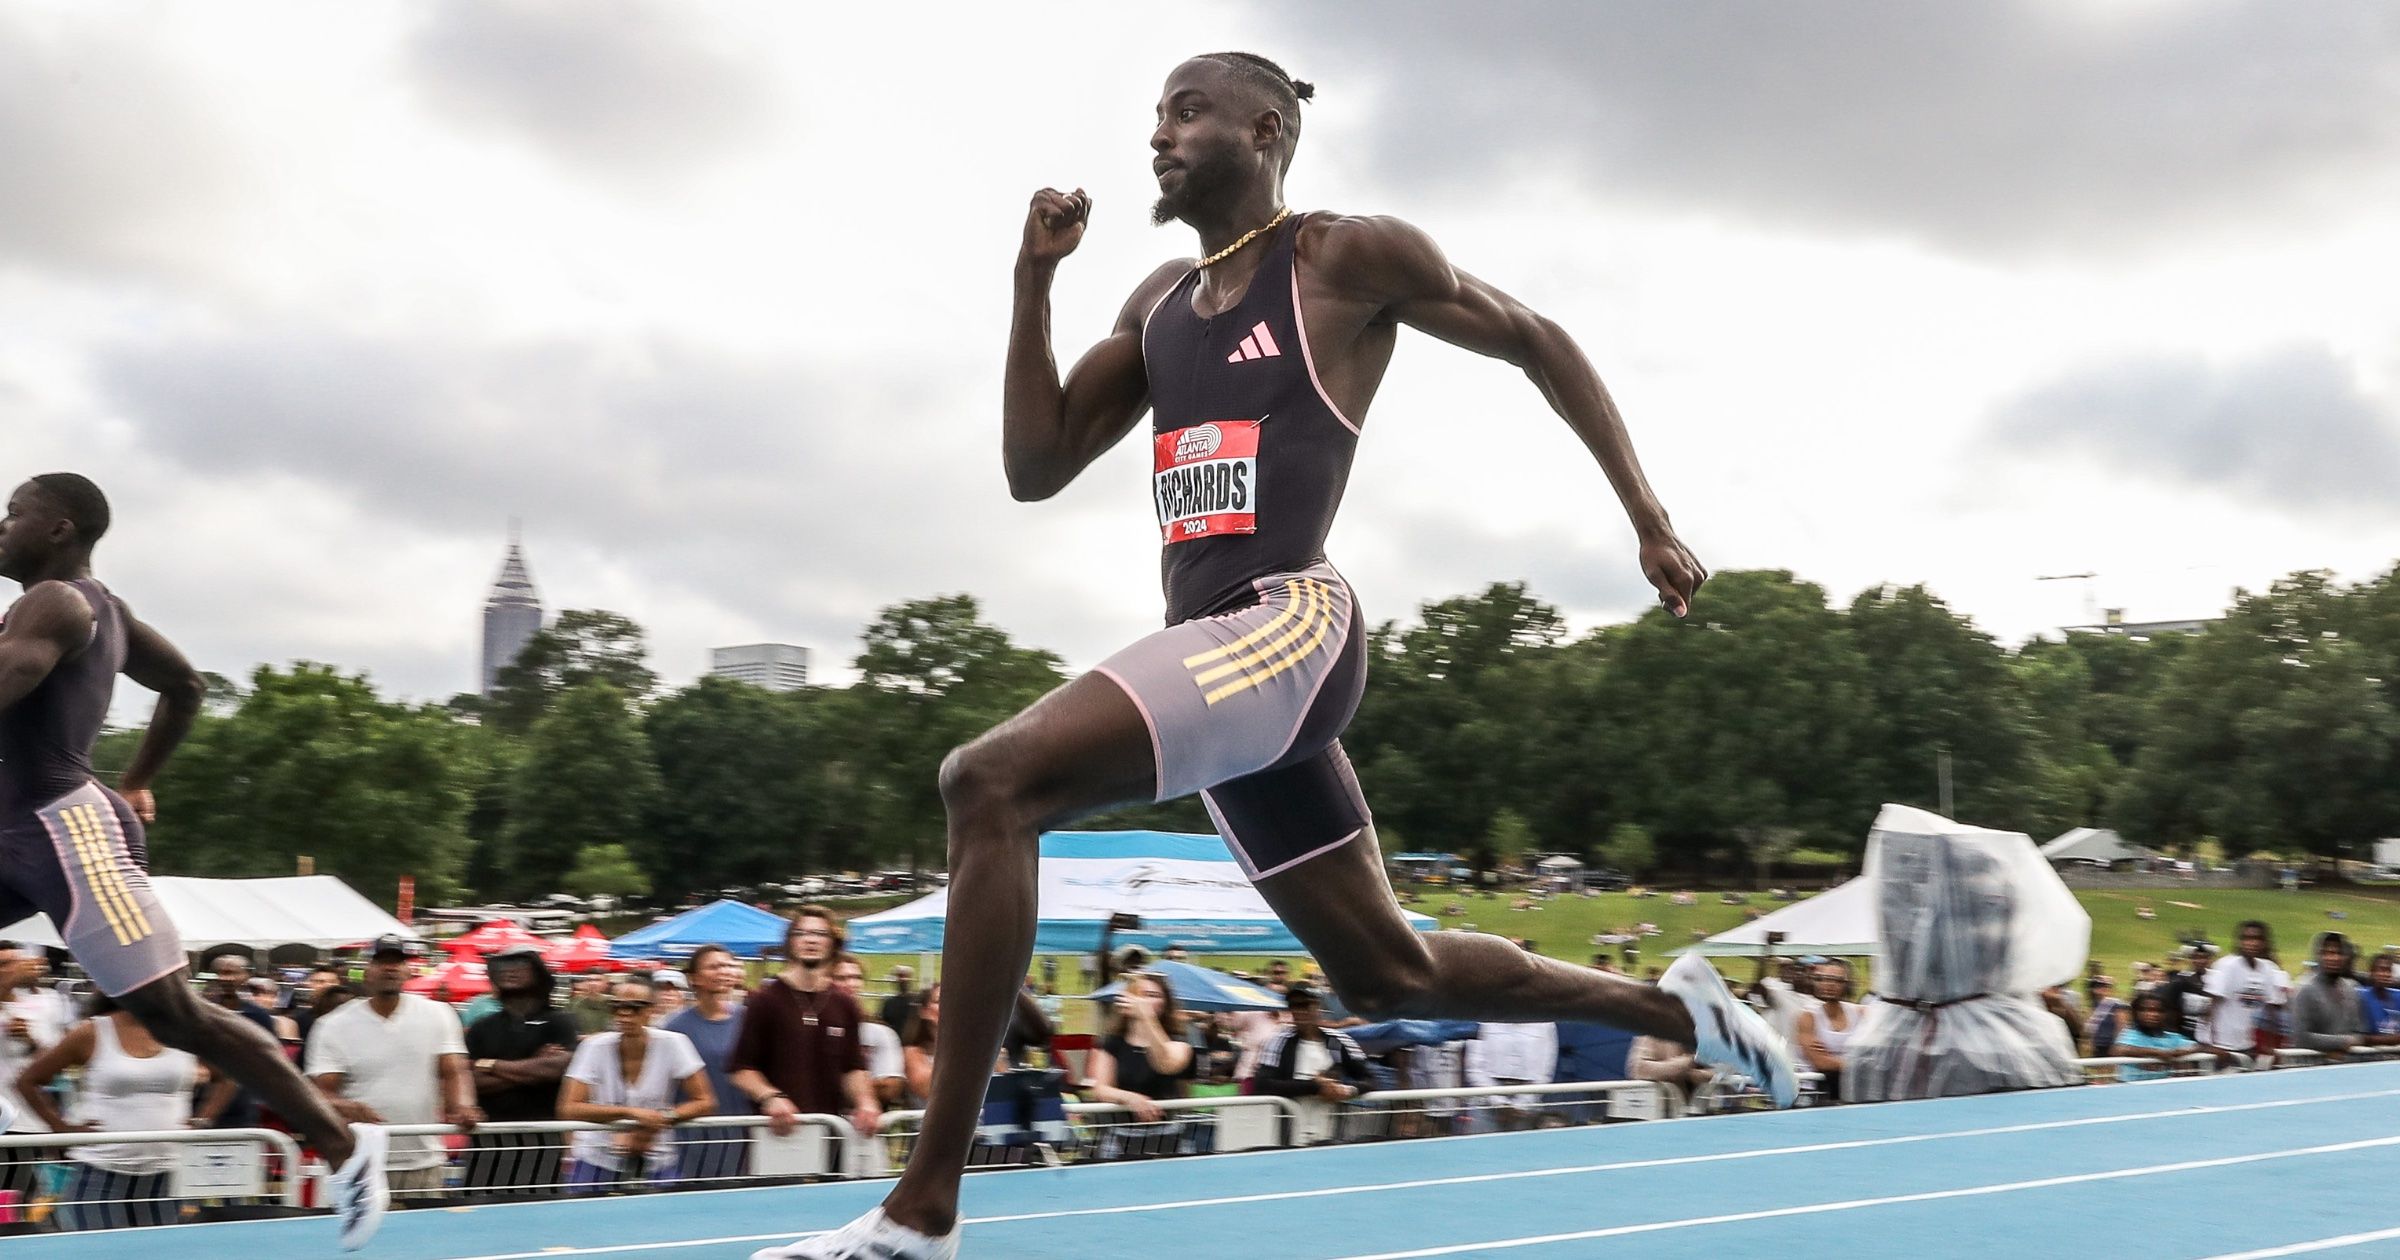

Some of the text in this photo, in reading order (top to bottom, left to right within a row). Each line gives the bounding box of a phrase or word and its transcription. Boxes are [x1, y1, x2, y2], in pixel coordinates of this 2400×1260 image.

[1175, 440, 1208, 456] ATLANTA
[1174, 450, 1208, 463] CITY GAMES
[1160, 461, 1247, 521] RICHARDS
[1183, 519, 1207, 534] 2024
